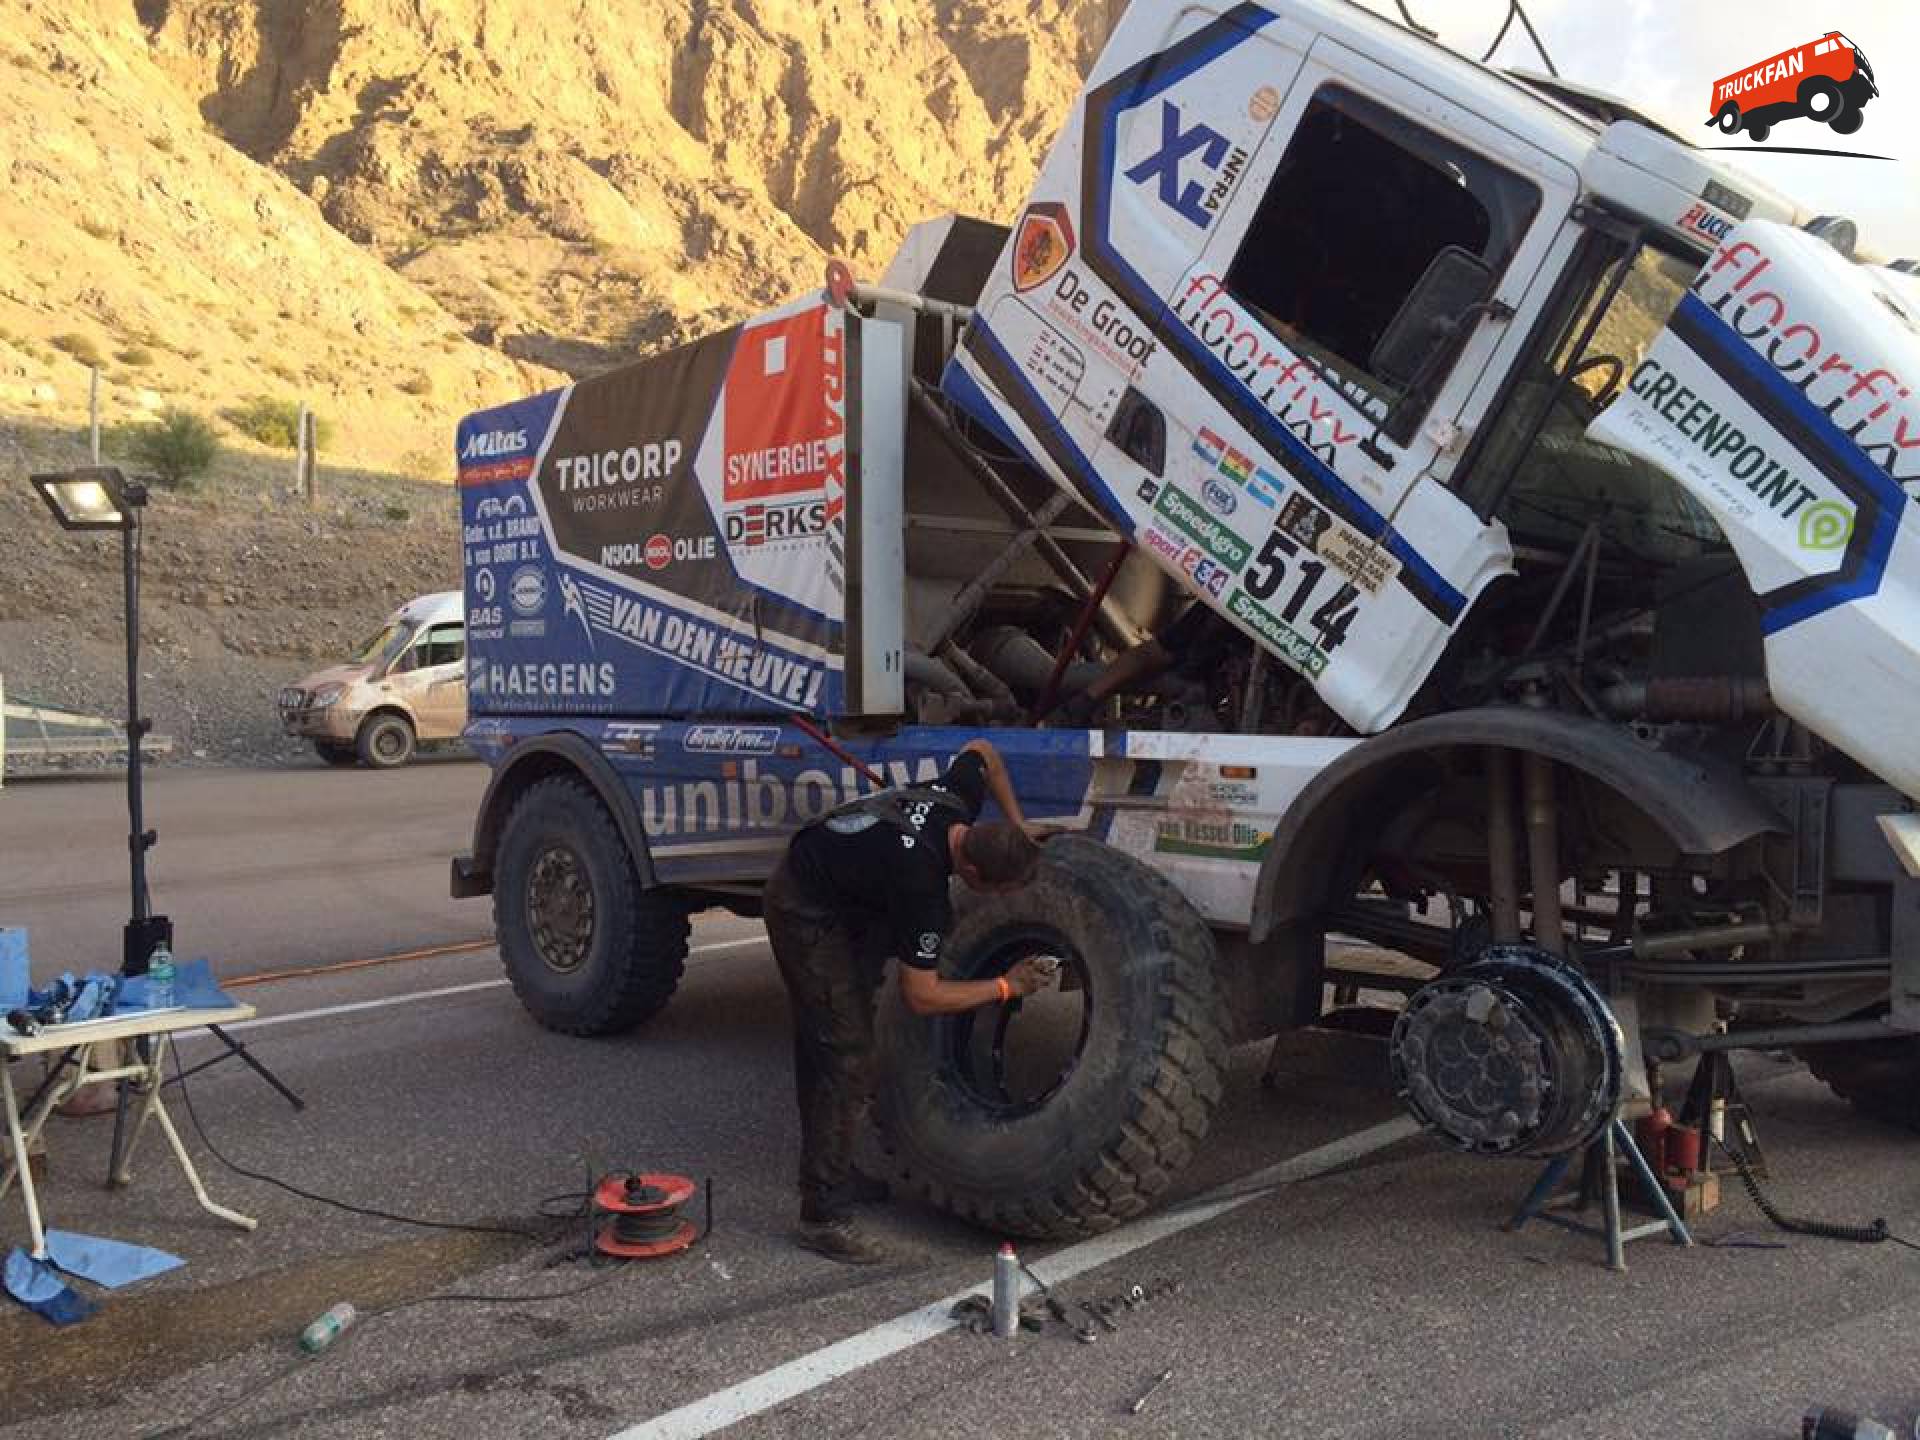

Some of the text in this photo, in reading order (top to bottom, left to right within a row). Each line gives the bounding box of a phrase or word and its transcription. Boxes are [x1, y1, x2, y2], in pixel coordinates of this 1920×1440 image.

[1204, 147, 1248, 210] INFRA
[1055, 269, 1089, 313] De
[1091, 299, 1157, 368] Groot
[461, 430, 528, 459] Mitas
[727, 440, 826, 485] SYNERGIE
[1628, 358, 1819, 521] GREENPOINT
[555, 439, 682, 491] TRICORP
[573, 485, 666, 513] WORKWEAR
[726, 504, 826, 544] DERKS
[1162, 490, 1243, 562] SpeedAgro
[675, 536, 716, 561] OLIE
[1244, 529, 1360, 654] 514
[469, 607, 503, 625] BAS
[609, 594, 824, 708] VAN DEN HEUVEL
[490, 662, 616, 696] HAEGENS
